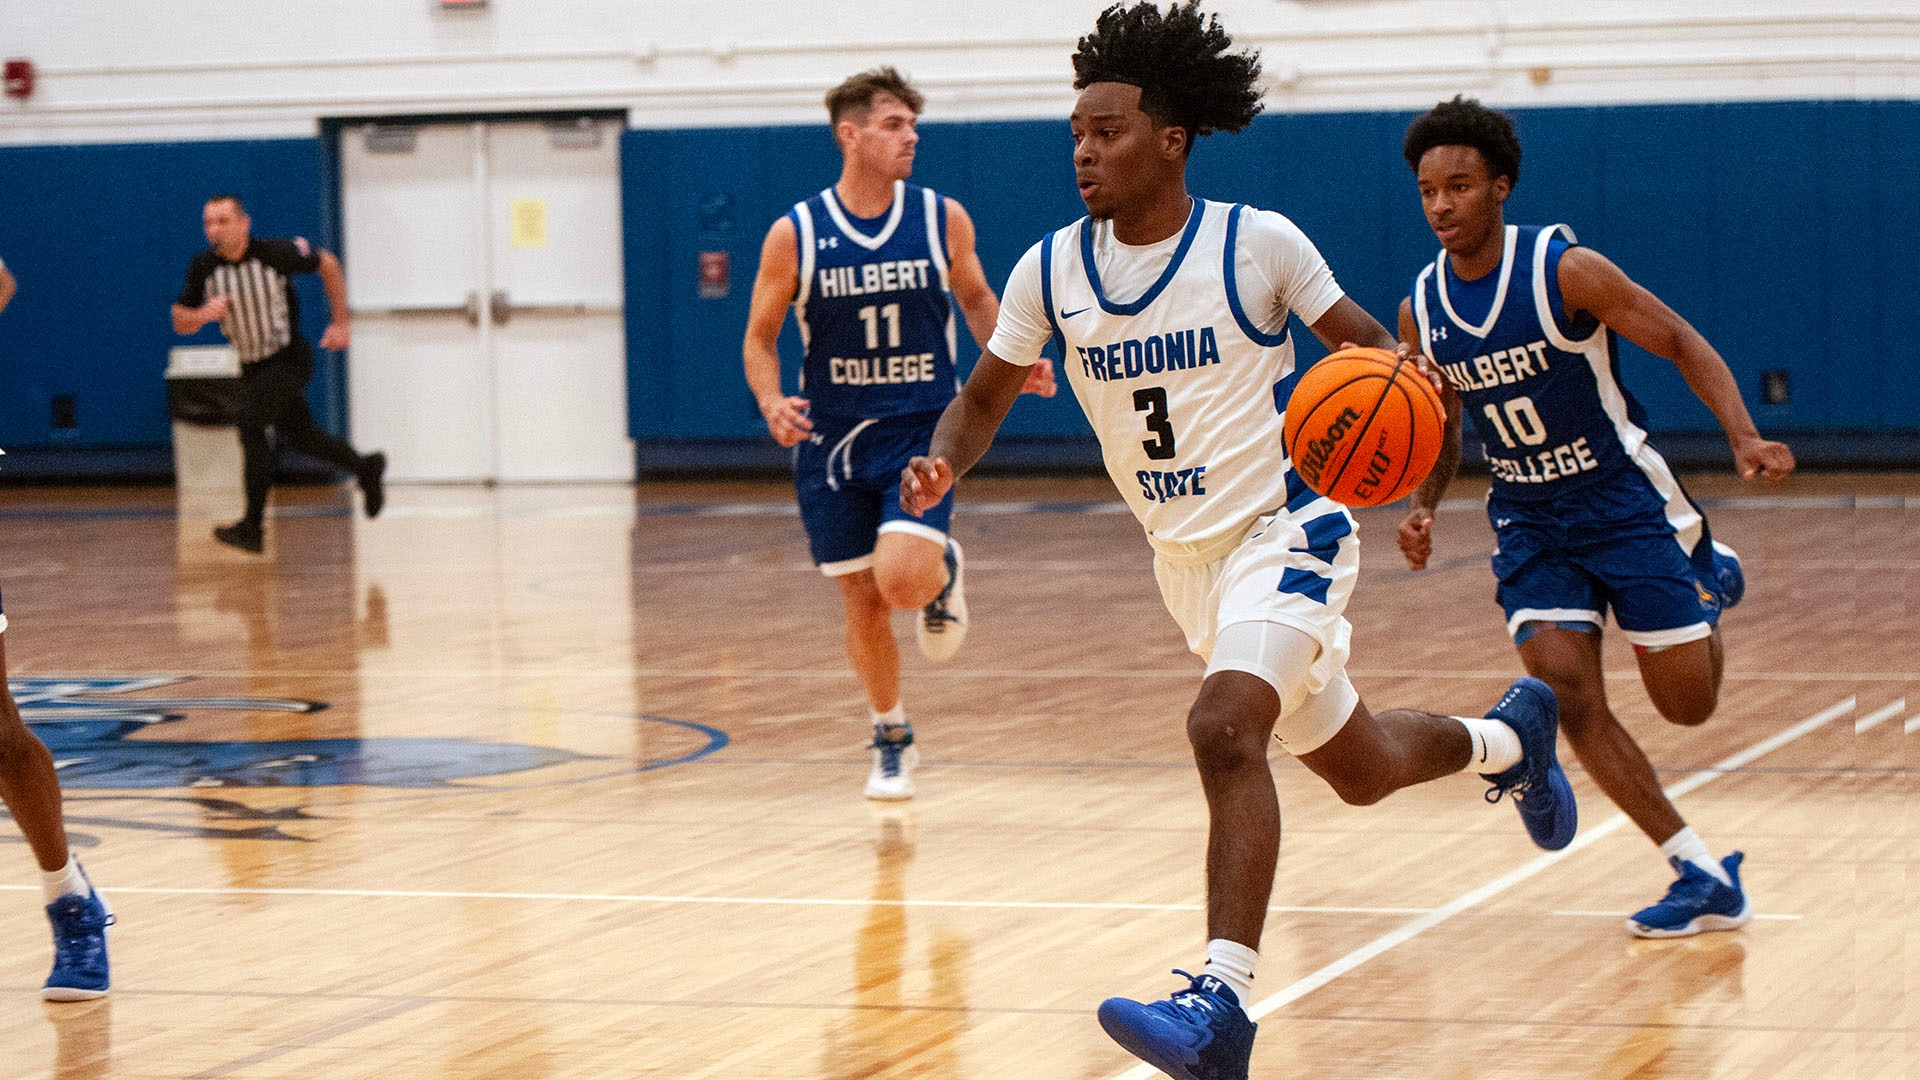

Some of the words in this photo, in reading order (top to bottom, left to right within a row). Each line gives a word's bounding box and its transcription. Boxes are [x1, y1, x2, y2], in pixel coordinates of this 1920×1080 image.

[818, 259, 929, 297] HILBERT
[858, 303, 900, 349] 11
[829, 353, 935, 385] COLLEGE
[1076, 326, 1221, 382] FREDONIA
[1132, 386, 1176, 460] 3
[1300, 406, 1360, 487] Wilson
[1483, 396, 1547, 448] 10
[1136, 466, 1206, 503] STATE
[1354, 450, 1390, 499] EVO
